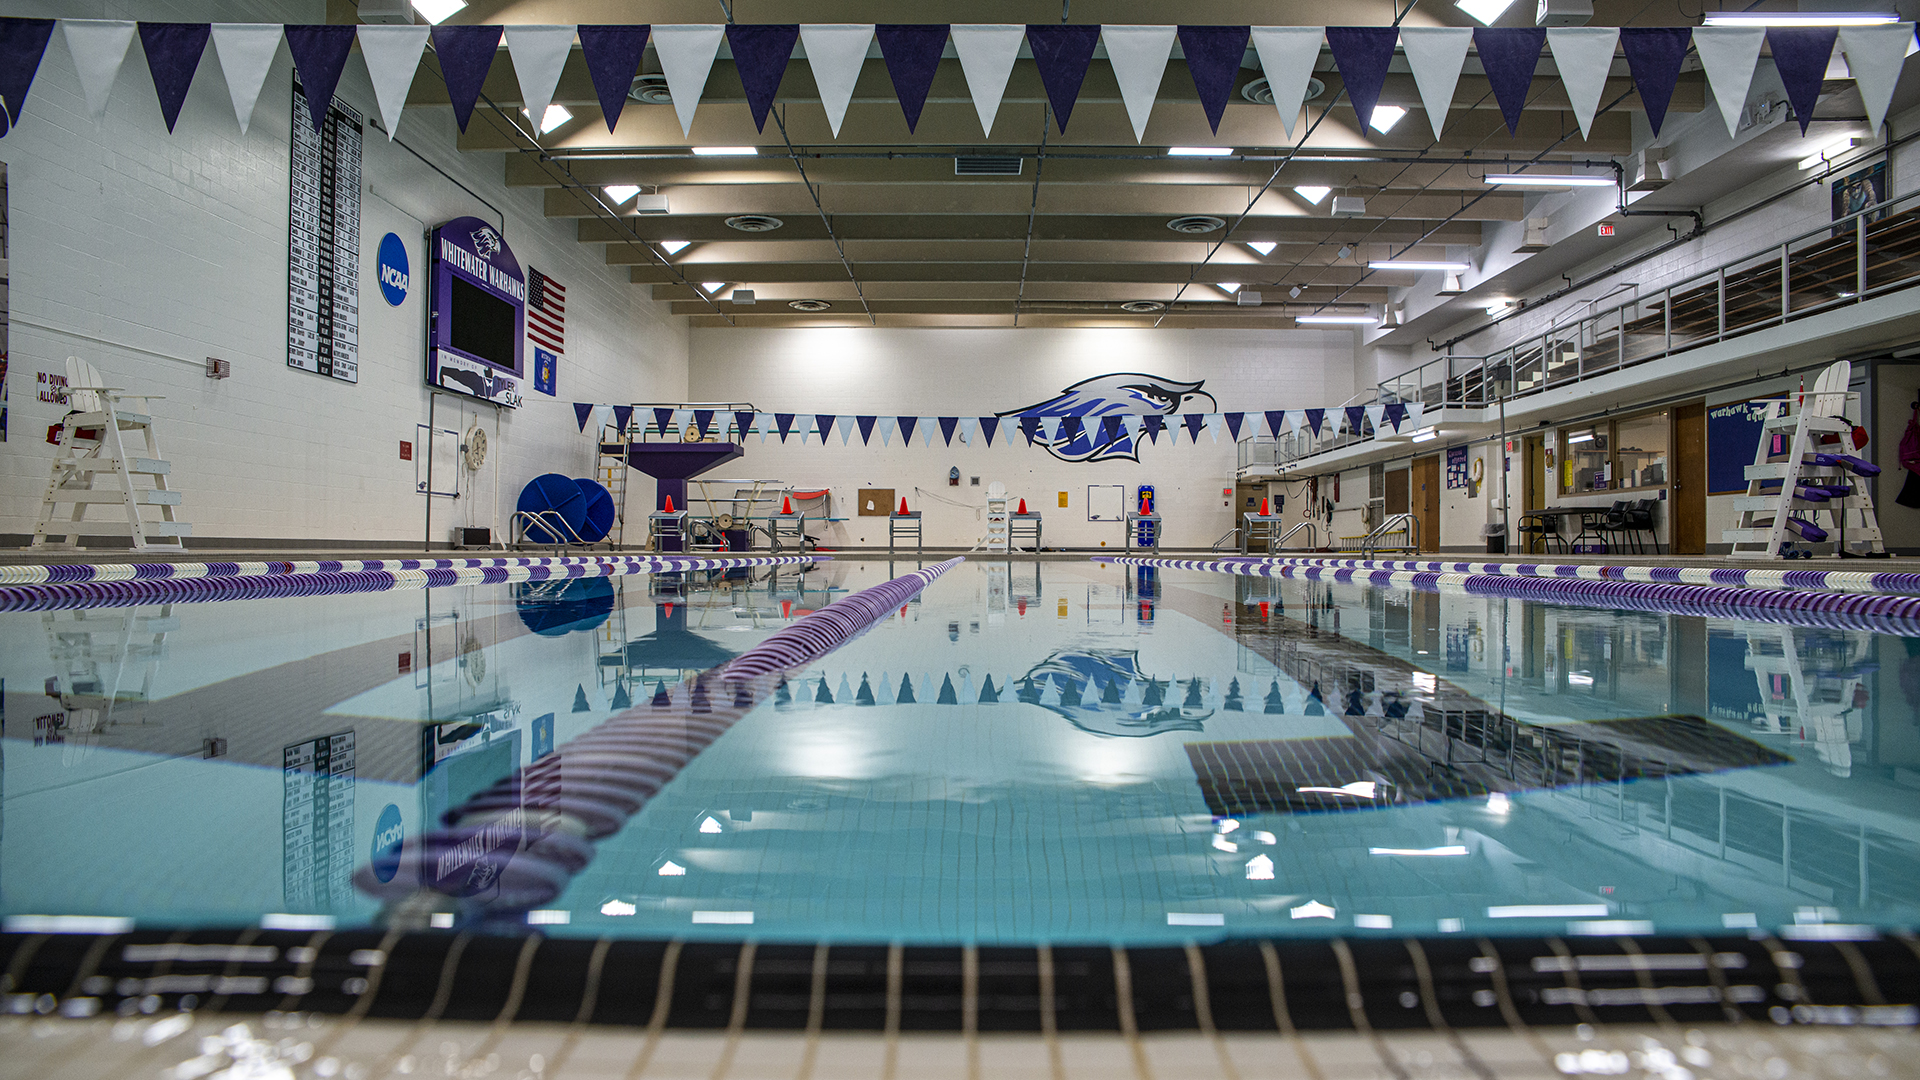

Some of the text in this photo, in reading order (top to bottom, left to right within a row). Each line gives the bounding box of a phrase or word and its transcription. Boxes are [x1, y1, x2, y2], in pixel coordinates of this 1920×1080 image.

[1601, 226, 1613, 235] EXIT
[441, 237, 524, 301] WHITEWATER WARHAWKS
[381, 263, 409, 293] NCAA
[37, 372, 47, 384] NO
[496, 378, 515, 392] TYLER
[505, 392, 523, 408] SLAK
[1710, 403, 1748, 419] warhawk
